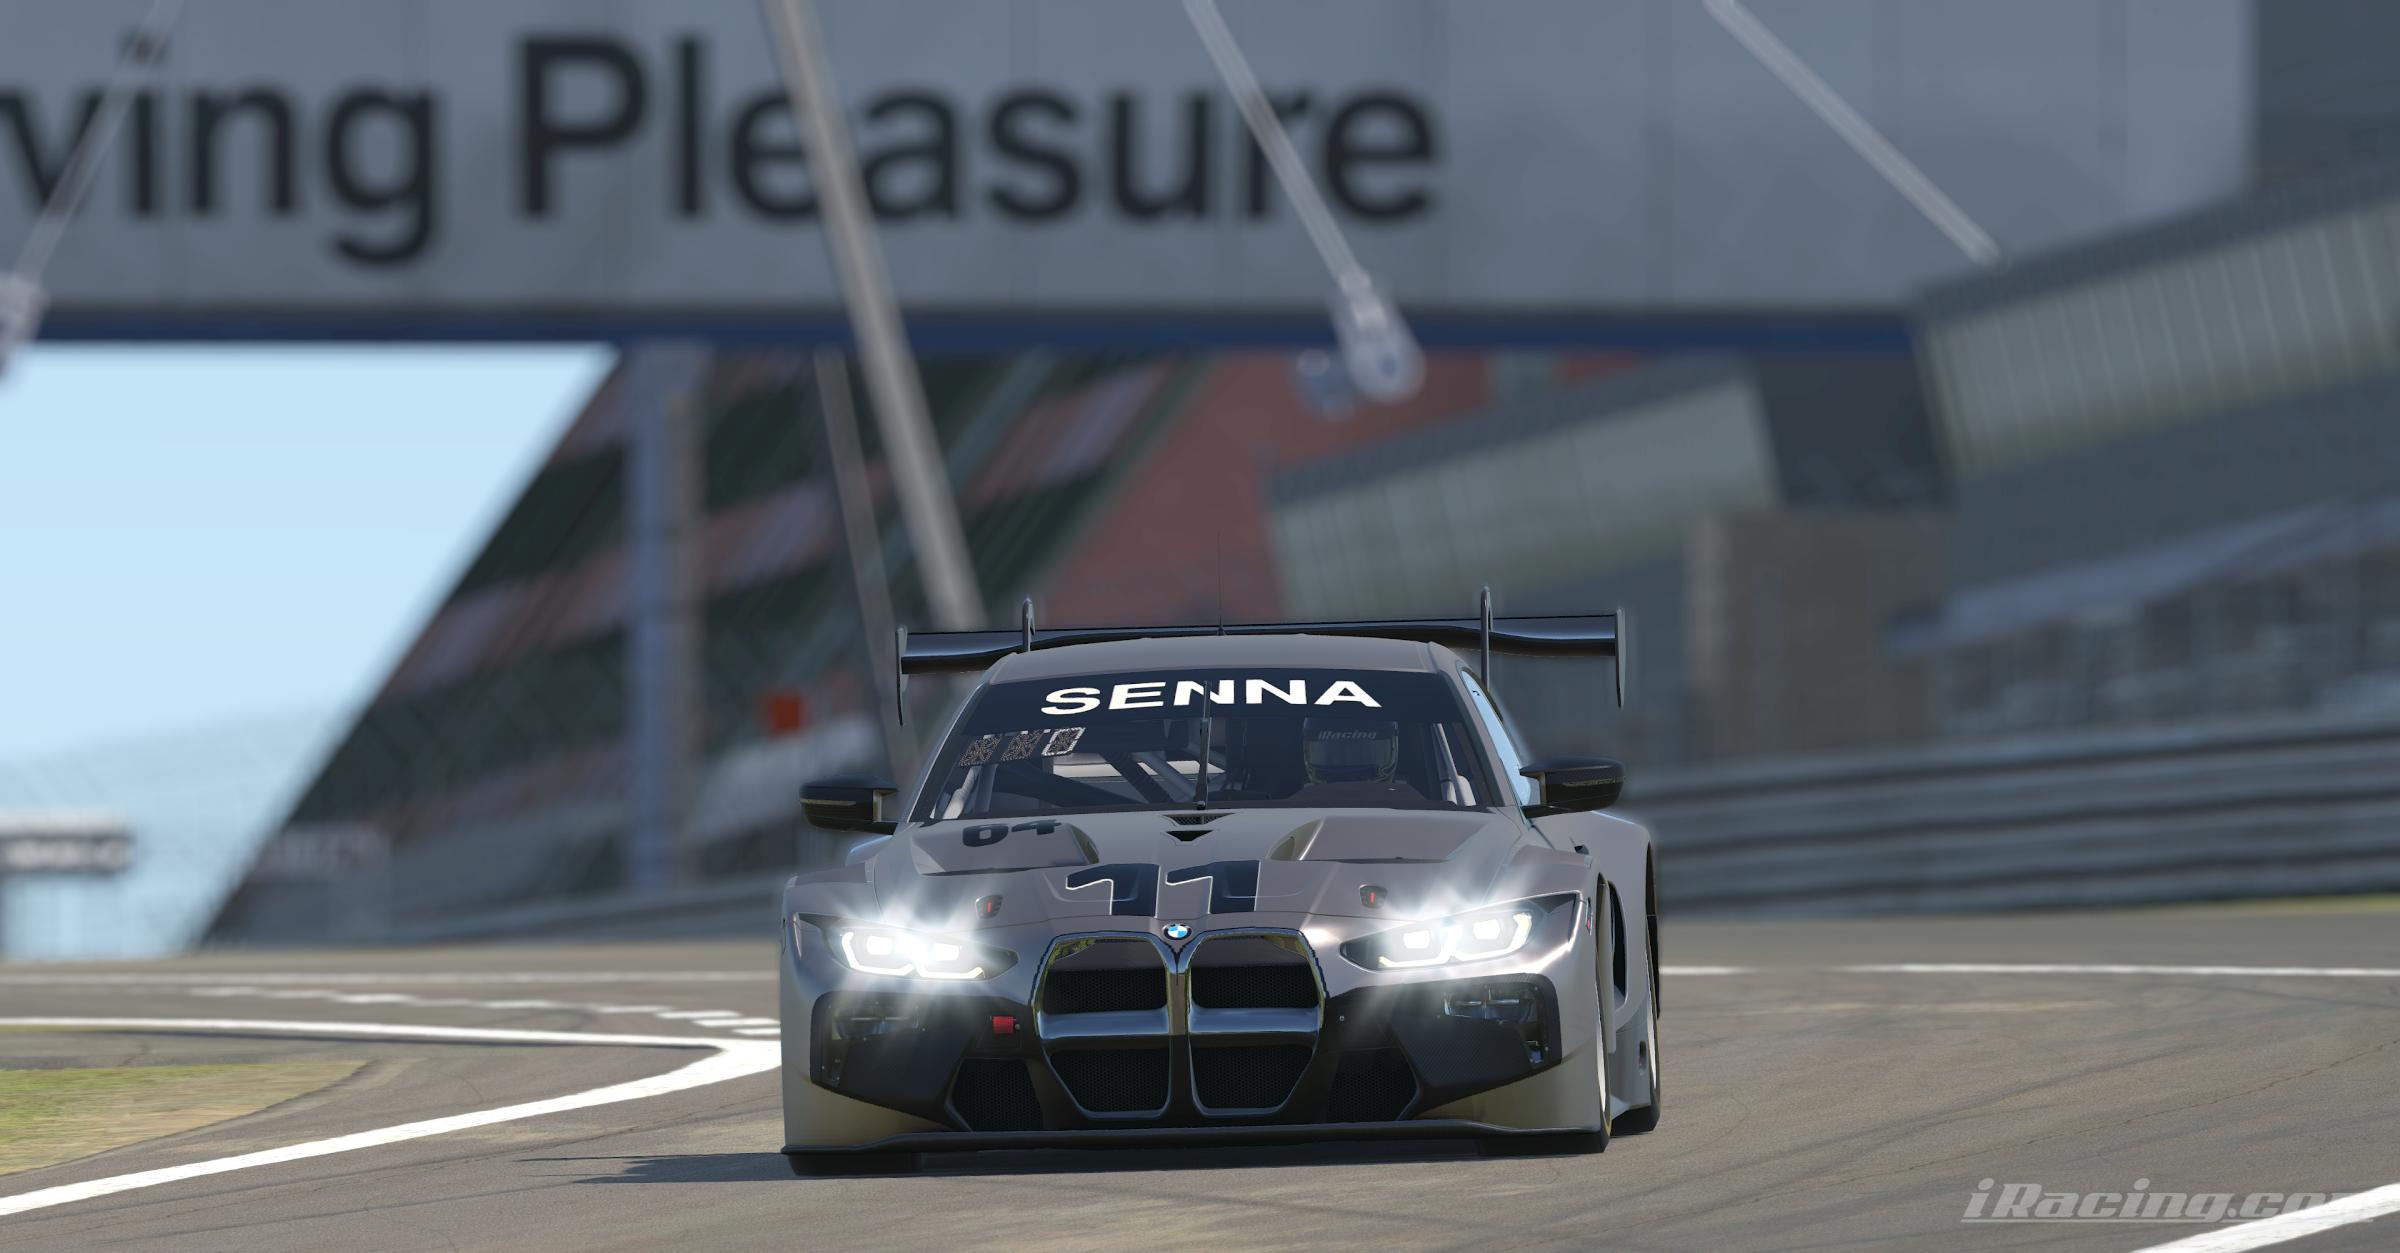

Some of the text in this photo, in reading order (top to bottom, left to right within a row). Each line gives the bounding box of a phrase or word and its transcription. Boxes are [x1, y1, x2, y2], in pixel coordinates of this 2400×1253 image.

[518, 33, 1440, 221] Pleasure
[1040, 679, 1383, 715] SENNA
[1065, 860, 1261, 918] 11
